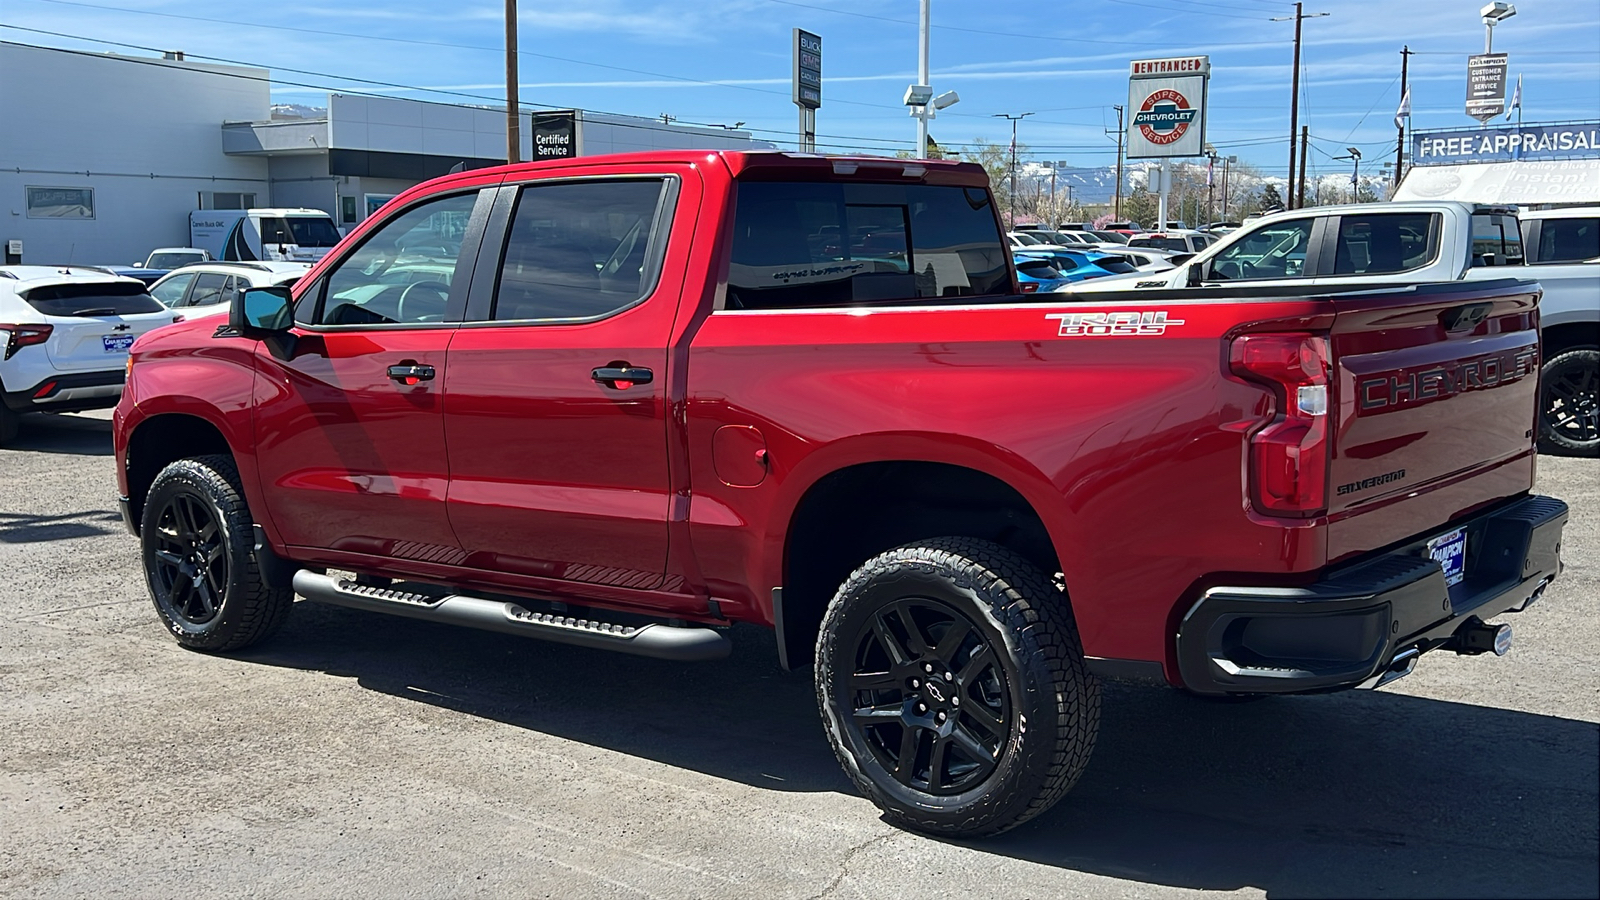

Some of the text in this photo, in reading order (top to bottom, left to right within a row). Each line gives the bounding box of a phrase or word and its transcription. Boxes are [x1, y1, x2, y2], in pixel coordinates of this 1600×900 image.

[801, 38, 821, 52] BUICK
[803, 54, 820, 68] GMC
[1141, 60, 1194, 73] ENTRANCE
[1470, 58, 1507, 66] CHAMPION
[801, 72, 821, 83] CADILLAC
[1147, 91, 1183, 105] SUPER
[1137, 112, 1192, 122] CHEVROLET
[536, 134, 569, 144] Certified
[1142, 125, 1185, 144] SERVICE
[537, 145, 568, 155] Service
[1420, 136, 1474, 158] FREE
[1508, 170, 1588, 183] Instant
[1044, 311, 1186, 325] TRAIL
[1057, 325, 1167, 336] BOSS
[1361, 347, 1538, 410] CHEVROLET
[1336, 468, 1406, 496] SILVERADO
[1429, 540, 1464, 562] CHAMPION
